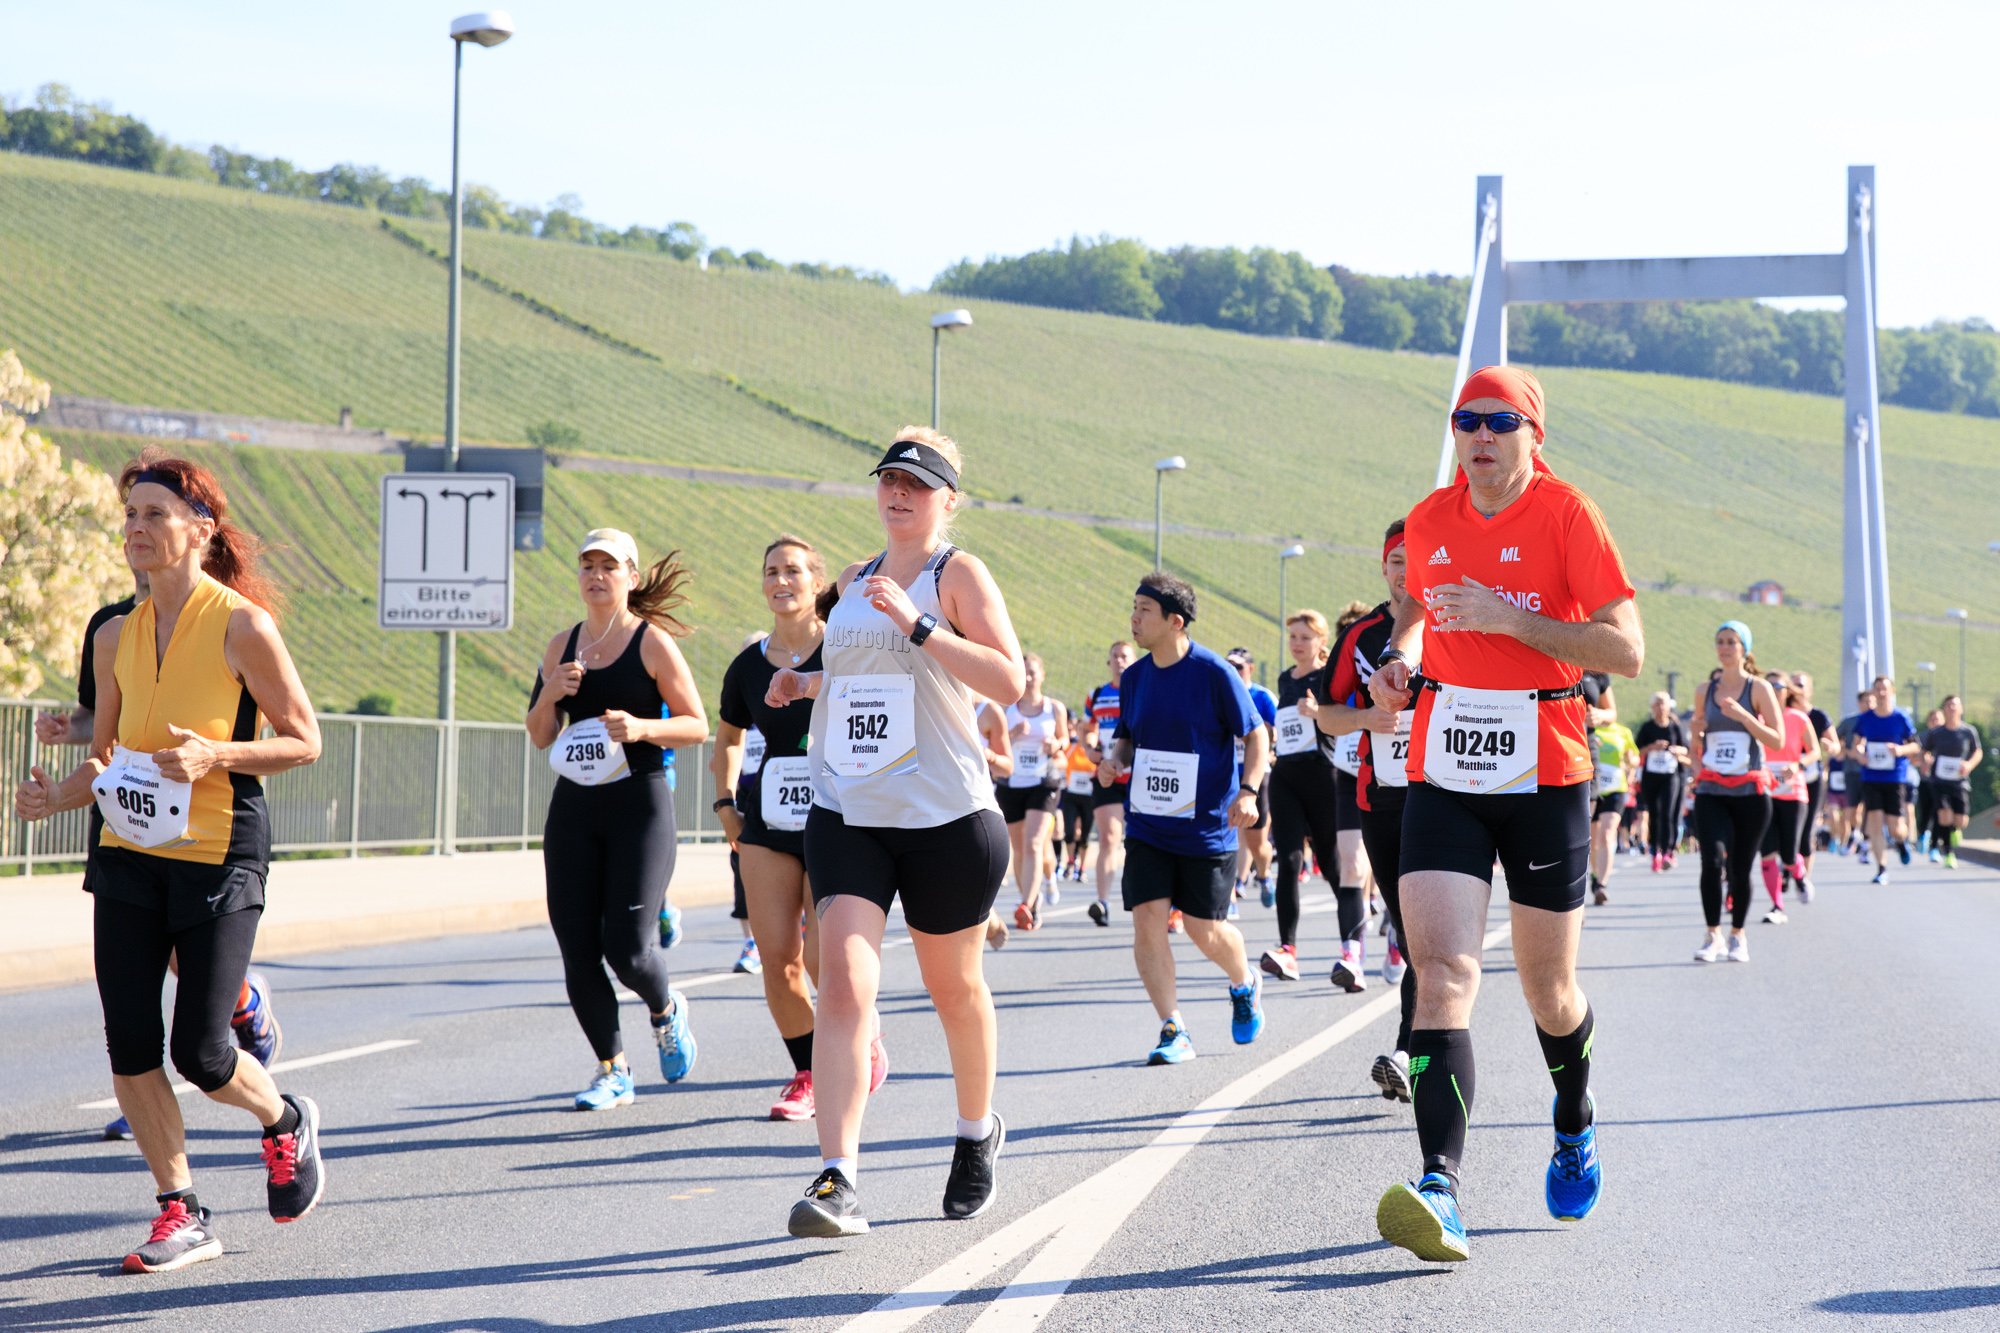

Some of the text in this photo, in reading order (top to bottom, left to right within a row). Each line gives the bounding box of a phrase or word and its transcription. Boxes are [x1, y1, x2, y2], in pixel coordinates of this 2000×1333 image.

[1428, 556, 1451, 566] adidas
[1500, 546, 1521, 563] ML
[418, 586, 471, 602] Bitte
[828, 625, 861, 648] JUST
[864, 629, 885, 650] DO
[850, 701, 886, 709] Halbmarathon
[847, 714, 889, 741] 1542
[1454, 714, 1503, 725] Halbmarathon
[852, 744, 879, 754] Kristina
[1443, 727, 1516, 757] 10249
[565, 742, 606, 763] 2398
[1457, 759, 1498, 771] Matthias
[1146, 775, 1180, 794] 1396
[116, 786, 156, 819] 805
[779, 786, 815, 806] 243
[127, 814, 150, 830] Gerda
